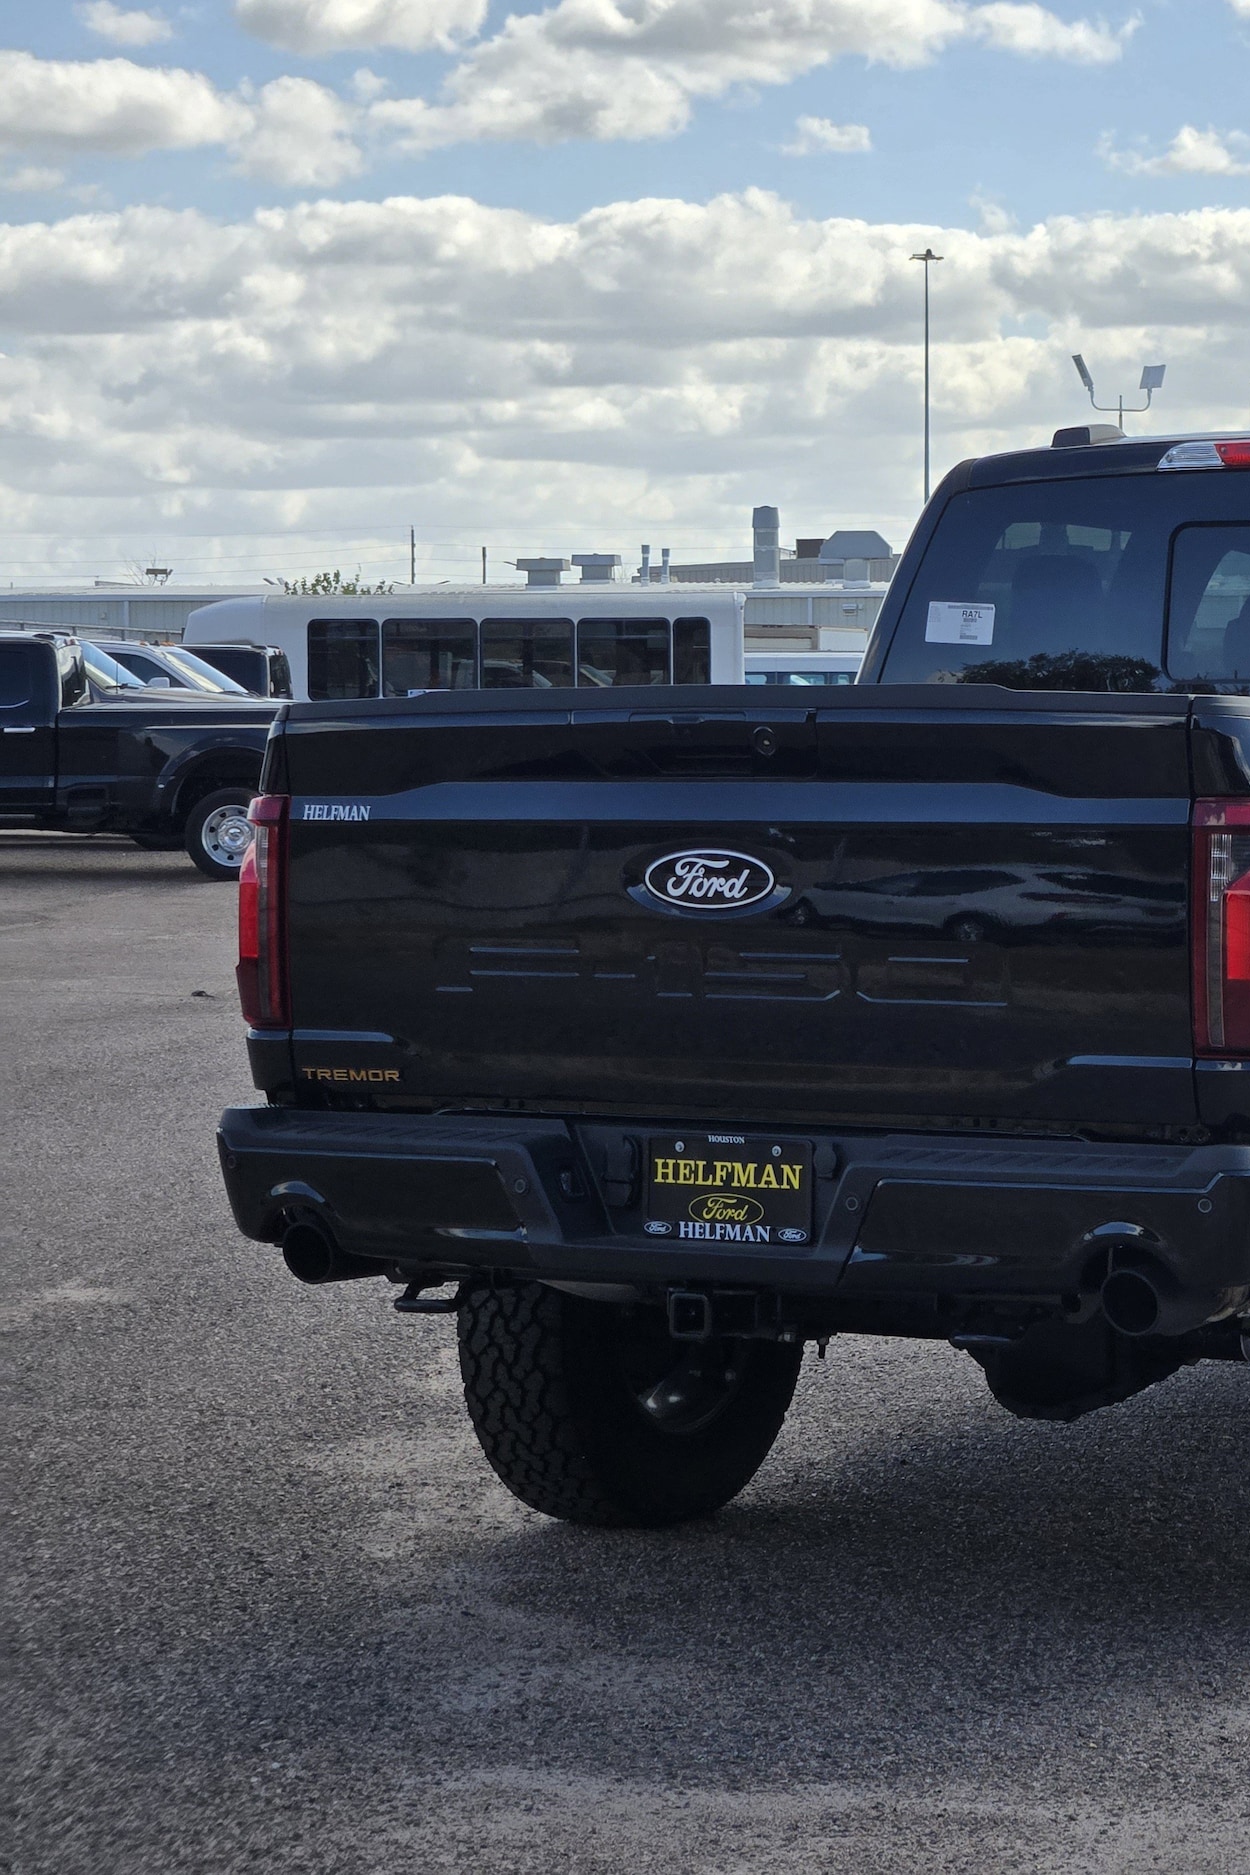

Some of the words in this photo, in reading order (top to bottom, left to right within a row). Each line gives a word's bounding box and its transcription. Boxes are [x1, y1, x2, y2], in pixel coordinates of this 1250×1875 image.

[961, 609, 983, 619] RA7L
[302, 804, 371, 821] HELFMAN
[666, 857, 751, 899] Ford
[302, 1067, 400, 1082] TREMOR
[707, 1134, 745, 1145] HOUSTON
[653, 1158, 803, 1190] HELFMAN
[702, 1195, 749, 1222] Ford
[678, 1220, 771, 1243] HELFMAN
